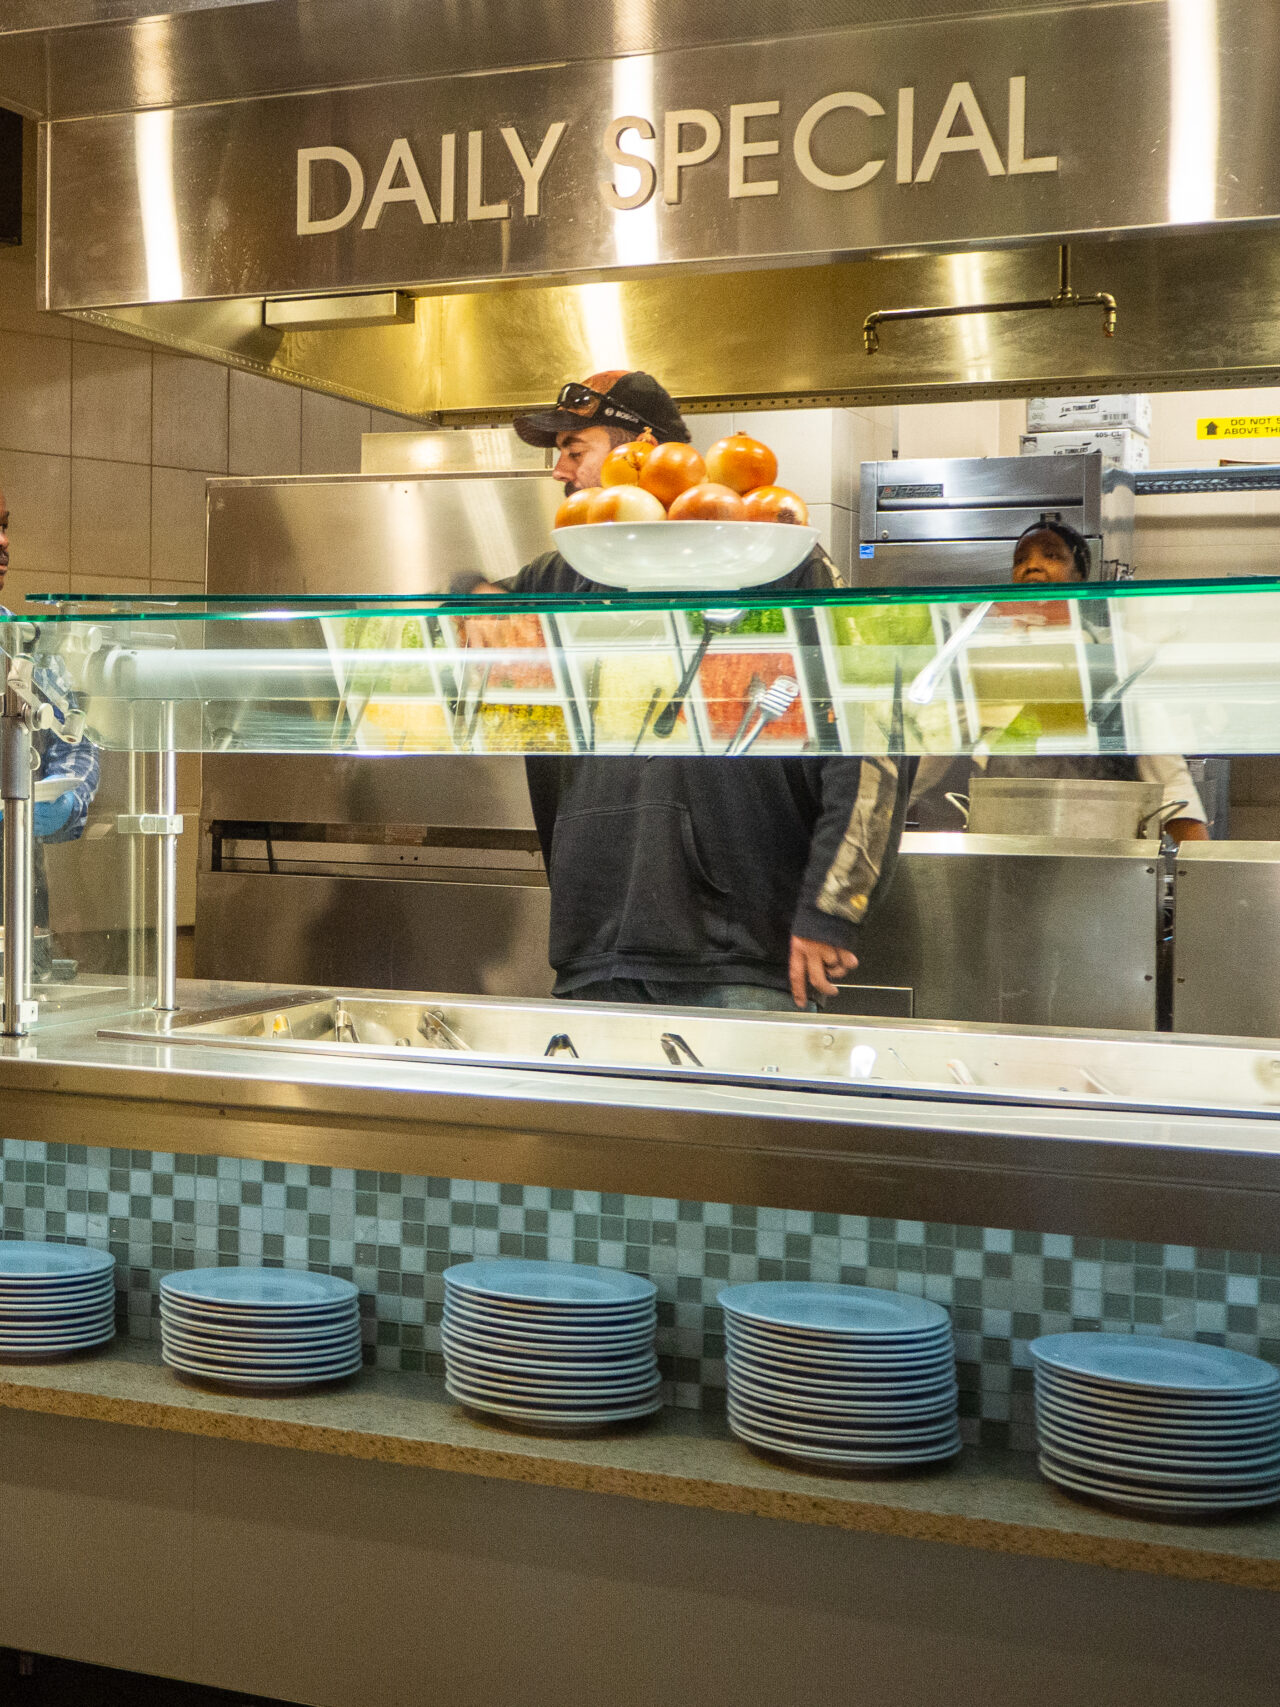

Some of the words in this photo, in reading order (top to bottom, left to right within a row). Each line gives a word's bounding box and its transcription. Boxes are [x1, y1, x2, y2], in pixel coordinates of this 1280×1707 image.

[296, 121, 566, 235] DAILY
[601, 75, 1059, 210] SPECIAL
[1250, 417, 1272, 425] NOT
[1224, 427, 1261, 435] ABOVE
